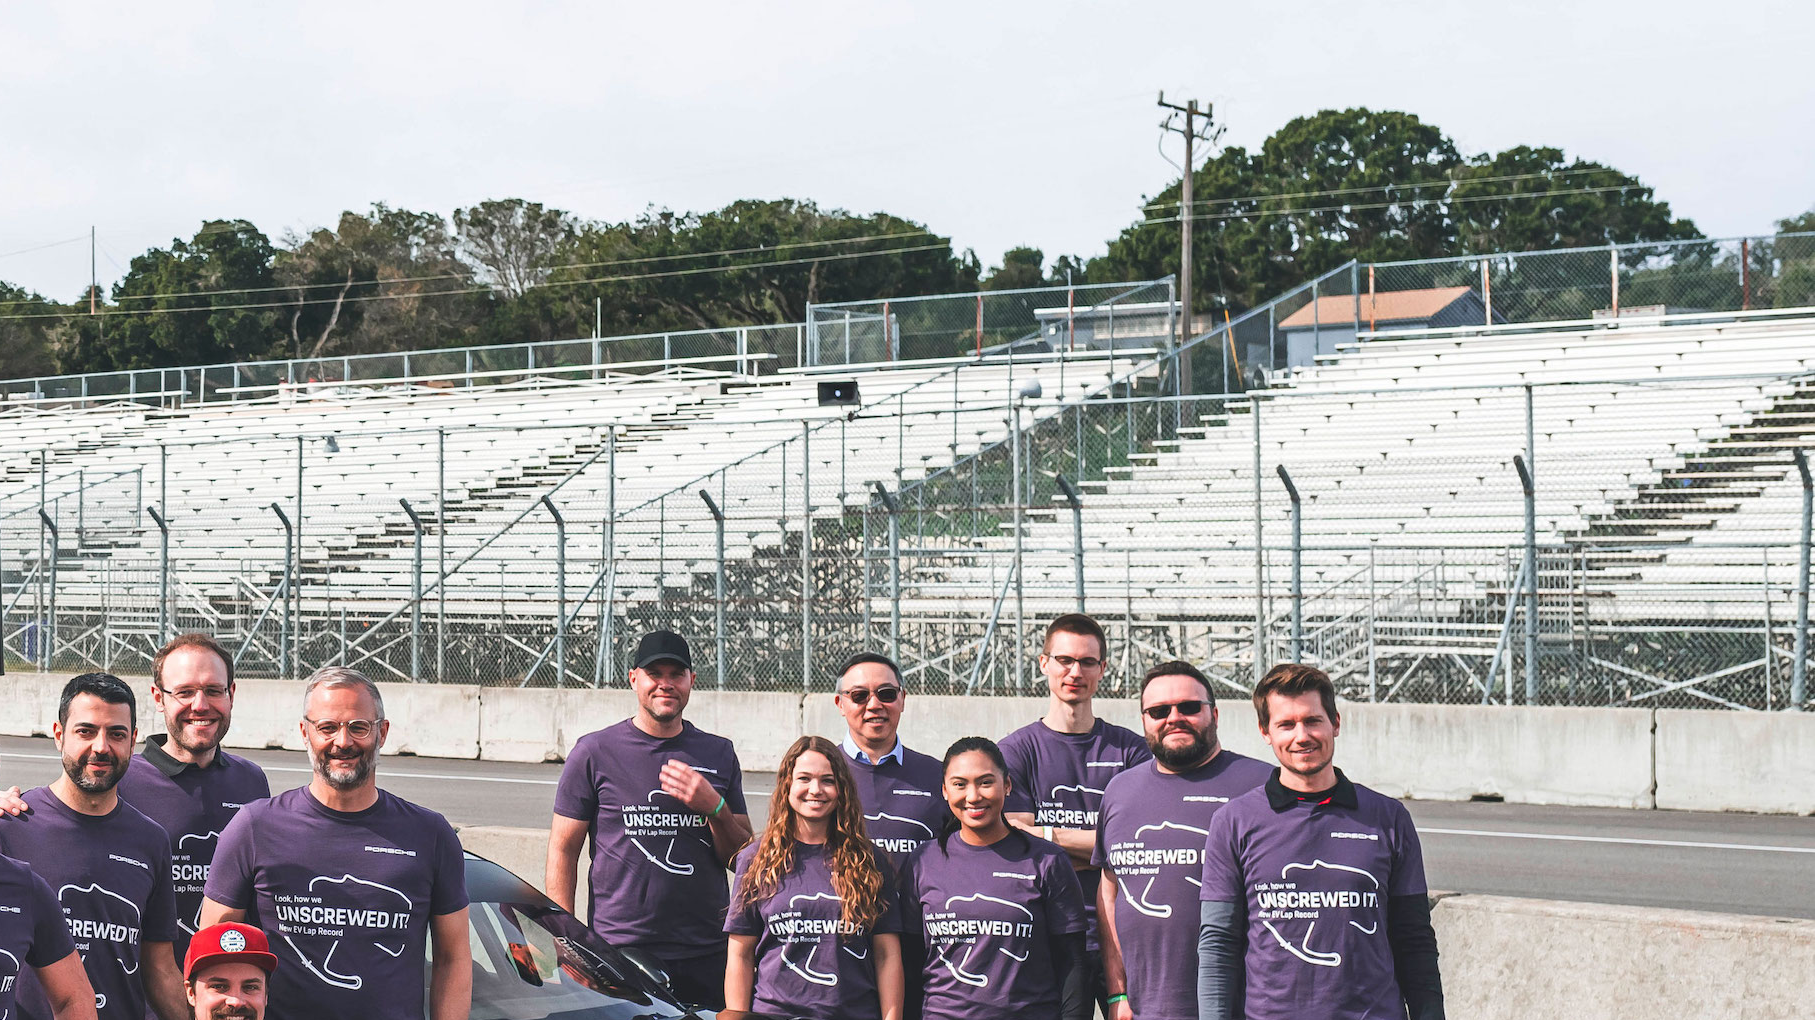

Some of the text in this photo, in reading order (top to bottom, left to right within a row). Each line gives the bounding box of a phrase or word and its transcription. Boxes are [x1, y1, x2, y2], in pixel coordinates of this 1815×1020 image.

[365, 846, 417, 857] PORSCHE
[1109, 849, 1197, 866] UNSCREWED
[173, 884, 204, 893] Lap Reco
[294, 895, 310, 903] how
[1257, 891, 1360, 909] UNSCREWED
[275, 905, 410, 929] UNSCREWED IT!
[1294, 910, 1319, 919] Record
[293, 926, 303, 935] EV
[303, 927, 316, 936] Lap
[318, 927, 344, 937] Record
[926, 920, 1033, 938] UNSCREWED IT!
[75, 943, 90, 951] cord
